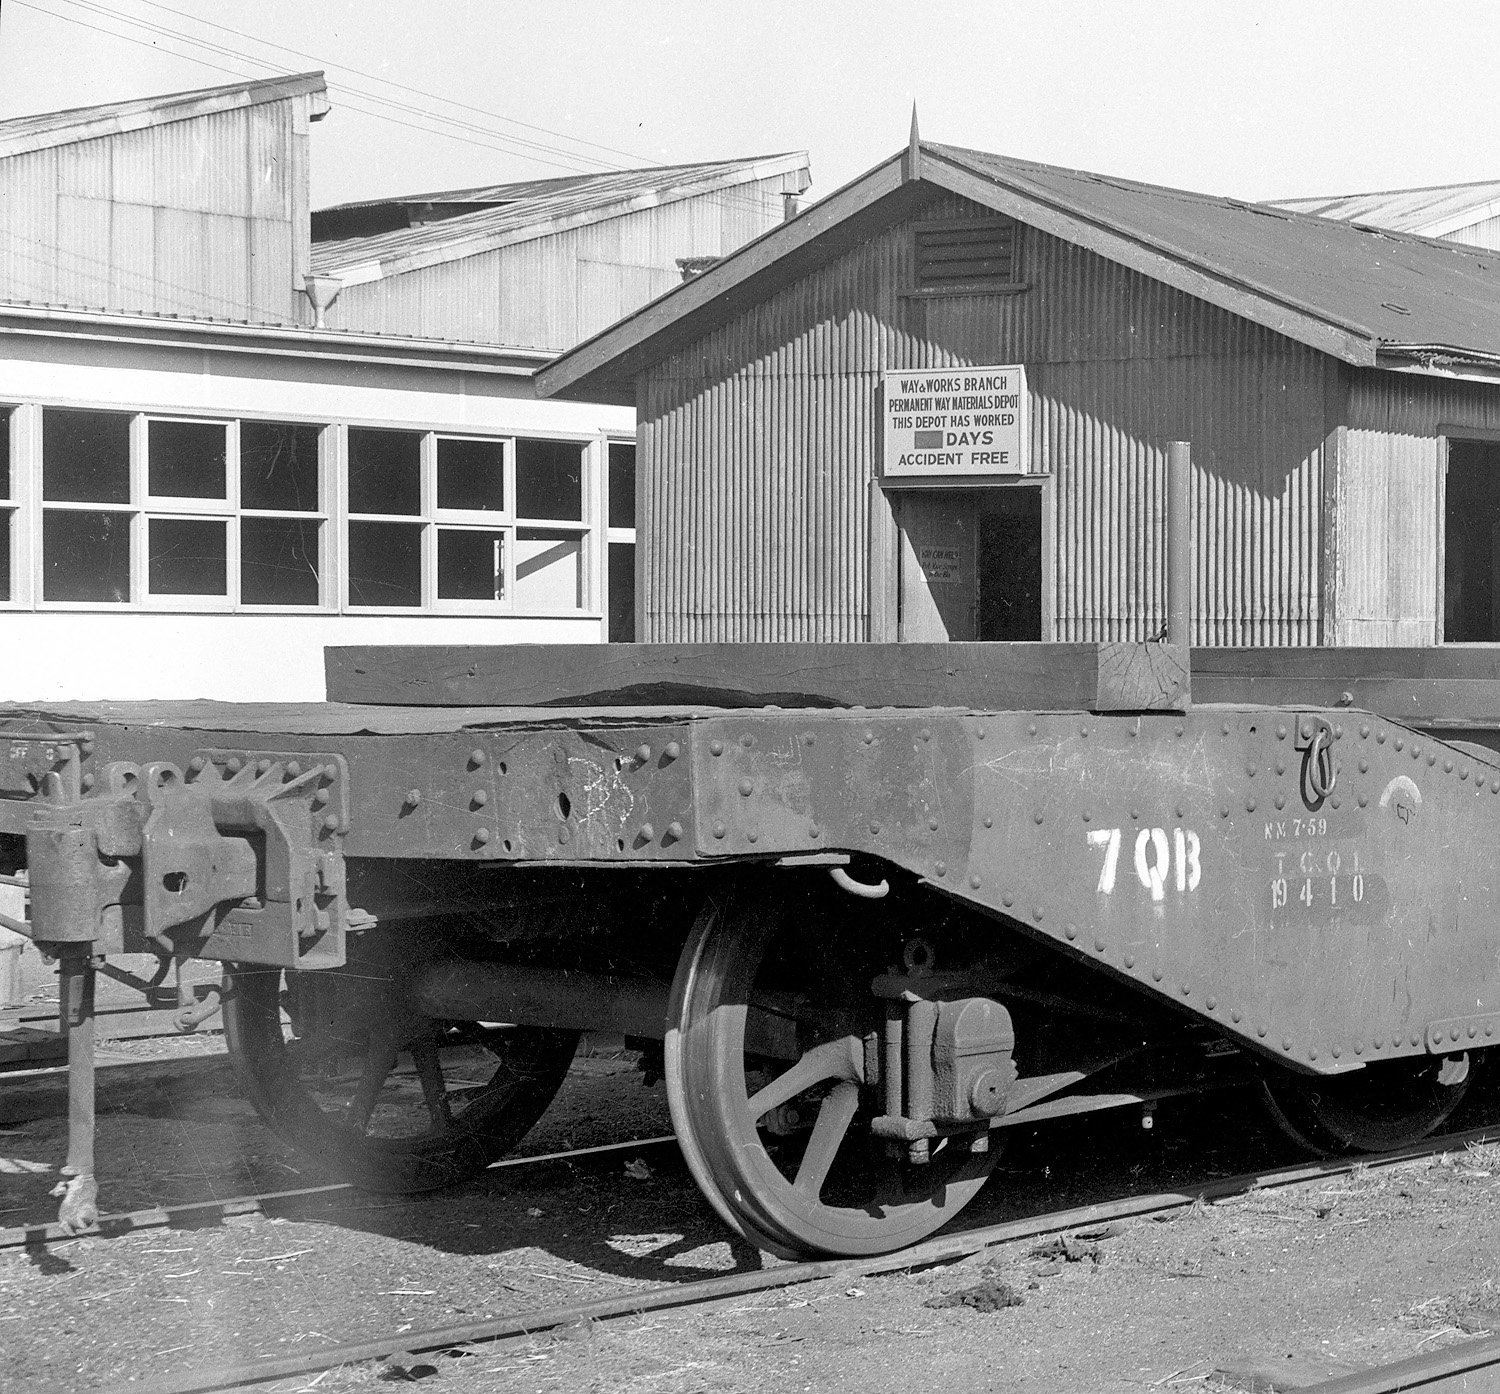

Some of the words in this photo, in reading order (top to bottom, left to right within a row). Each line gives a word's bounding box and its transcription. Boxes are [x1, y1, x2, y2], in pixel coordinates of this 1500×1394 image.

[964, 376, 1007, 391] BRANCH
[889, 398, 933, 412] PERMANENT
[935, 397, 951, 410] WAY
[952, 396, 993, 410] MATERIALS
[994, 395, 1019, 409] DEPOT
[893, 417, 913, 429] THIS
[916, 416, 947, 428] DEPOT
[951, 415, 970, 427] HAS
[974, 414, 1014, 426] WORKED
[947, 431, 993, 446] DAYS
[898, 453, 963, 465] ACCIDENT
[971, 452, 1009, 464] FREE
[1086, 827, 1201, 901] 7QB
